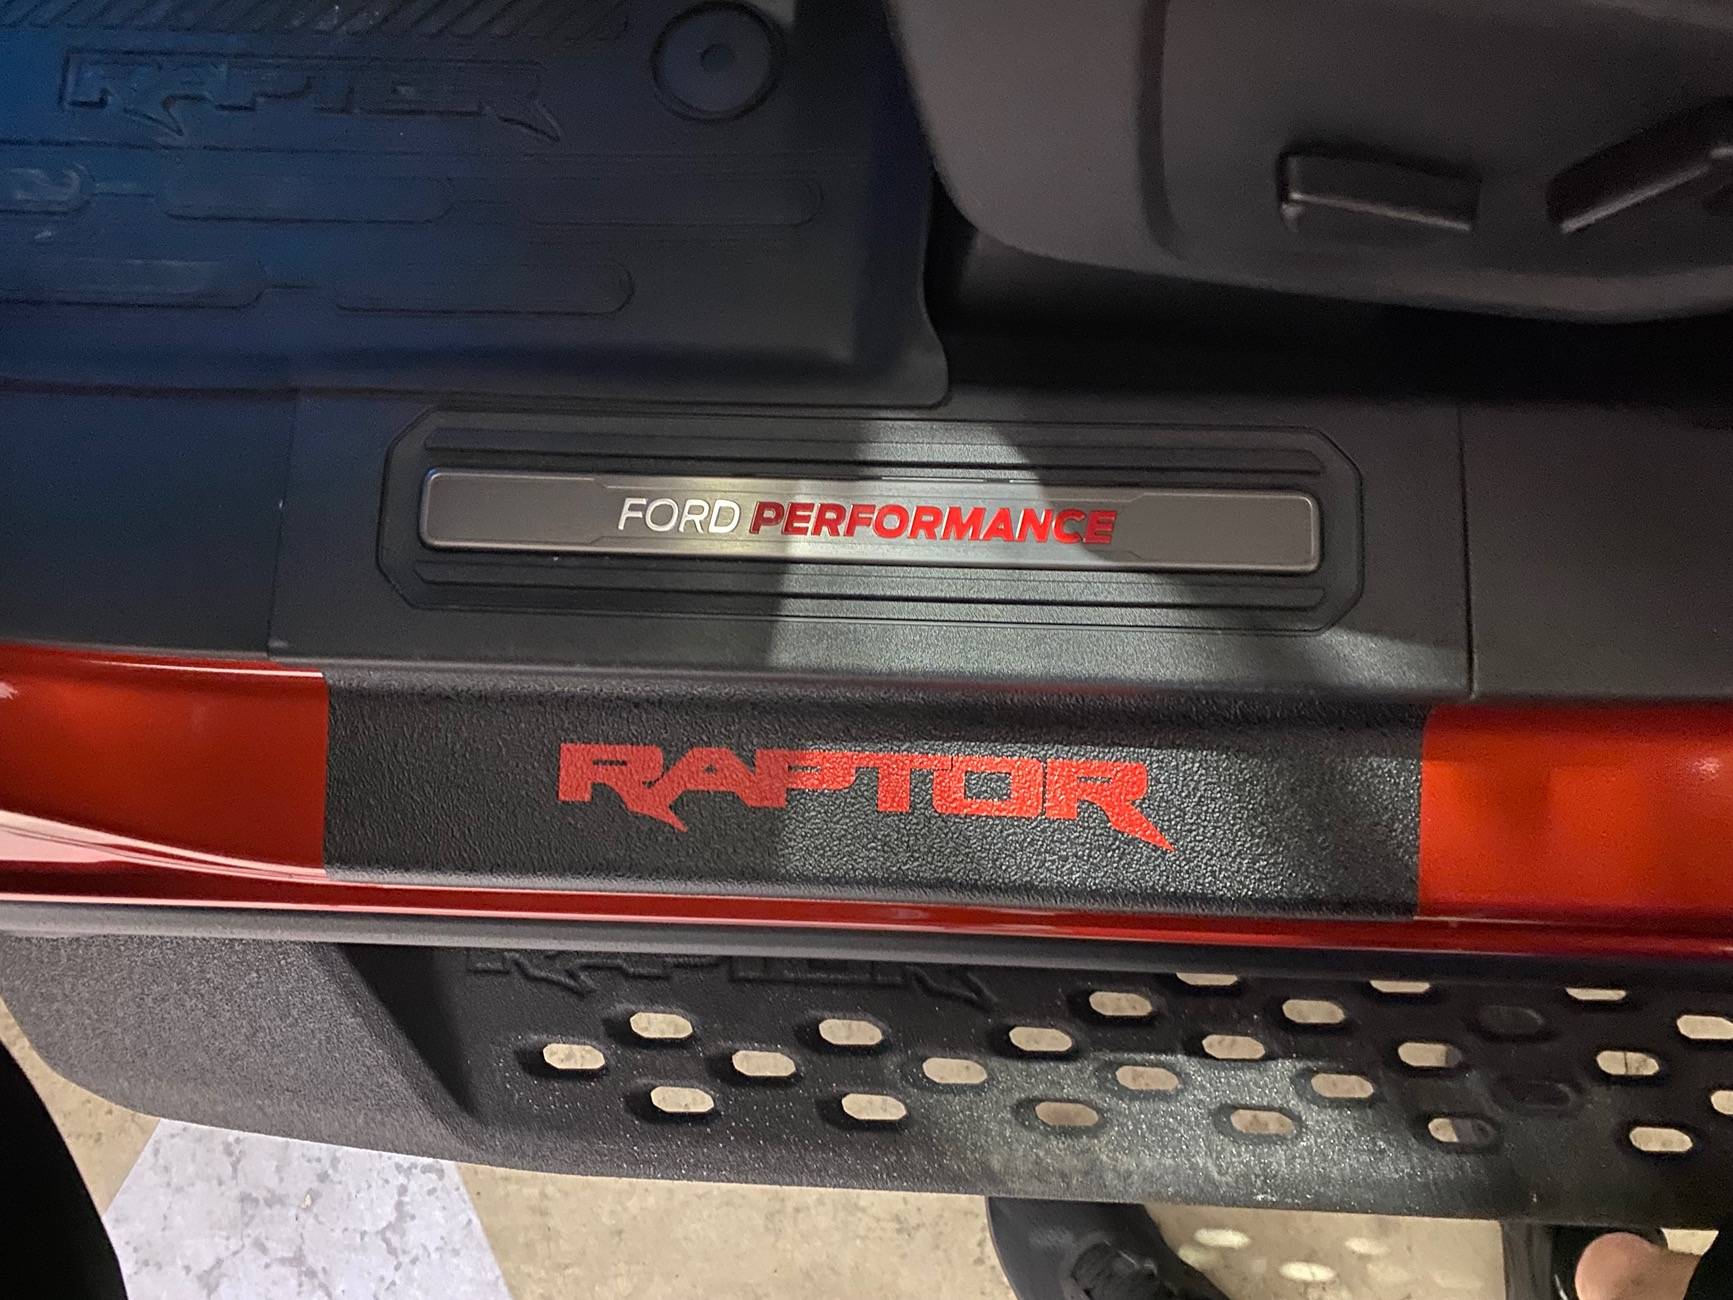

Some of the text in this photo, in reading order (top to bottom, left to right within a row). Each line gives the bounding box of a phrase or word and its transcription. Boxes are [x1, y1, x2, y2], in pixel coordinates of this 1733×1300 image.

[617, 497, 1118, 545] FORD PERFORMANCE
[557, 742, 1174, 852] RAPTOR
